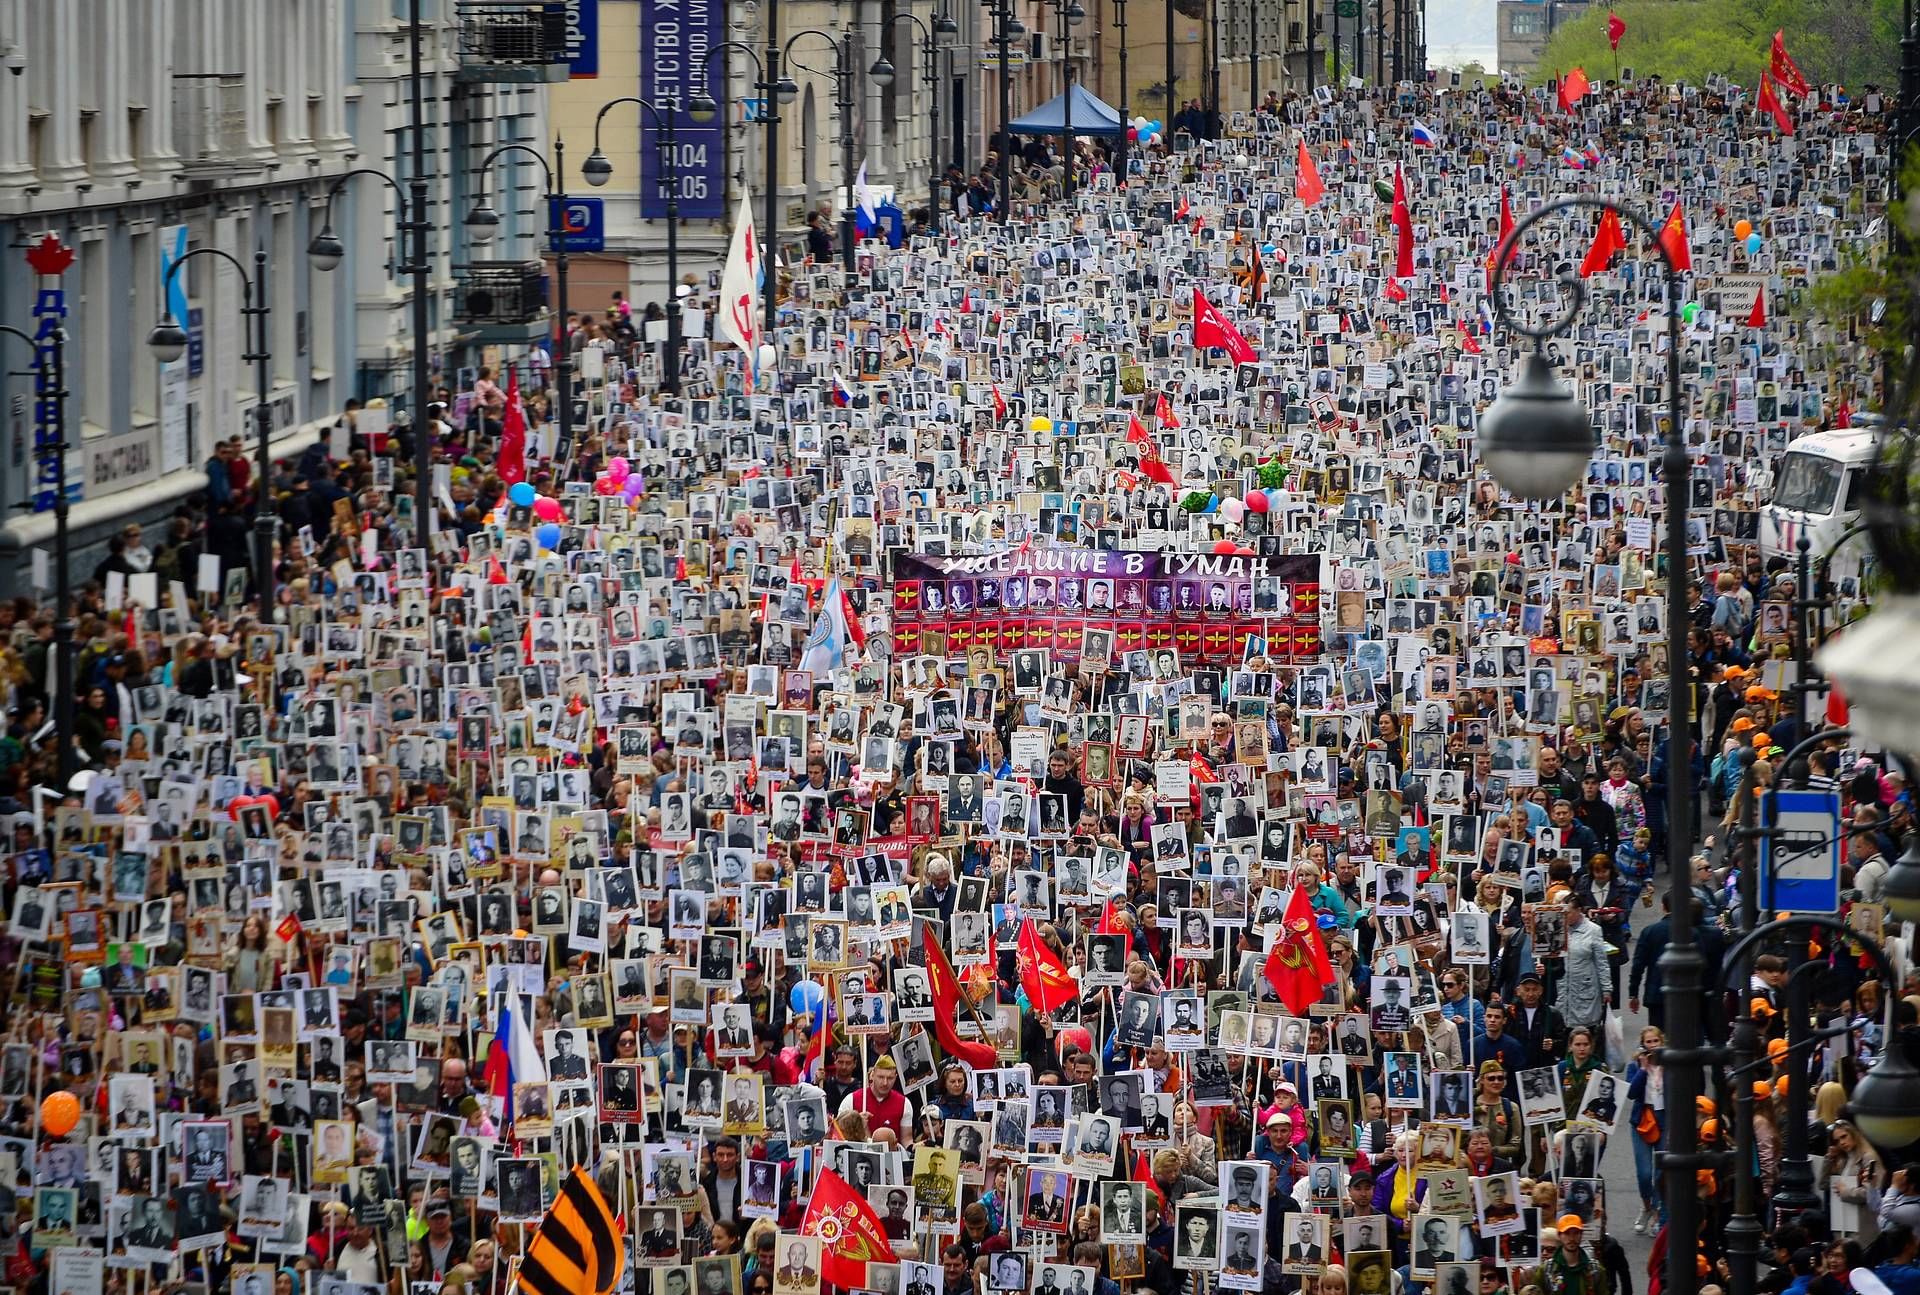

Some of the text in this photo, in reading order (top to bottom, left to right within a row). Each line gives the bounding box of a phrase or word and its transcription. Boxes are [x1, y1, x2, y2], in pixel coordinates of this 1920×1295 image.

[654, 17, 683, 112] ДЕТСТВО.
[688, 30, 708, 100] ILDHOOD.
[1123, 553, 1144, 574] В
[1161, 553, 1270, 577] ТУМАН
[876, 842, 908, 852] РОВЫ
